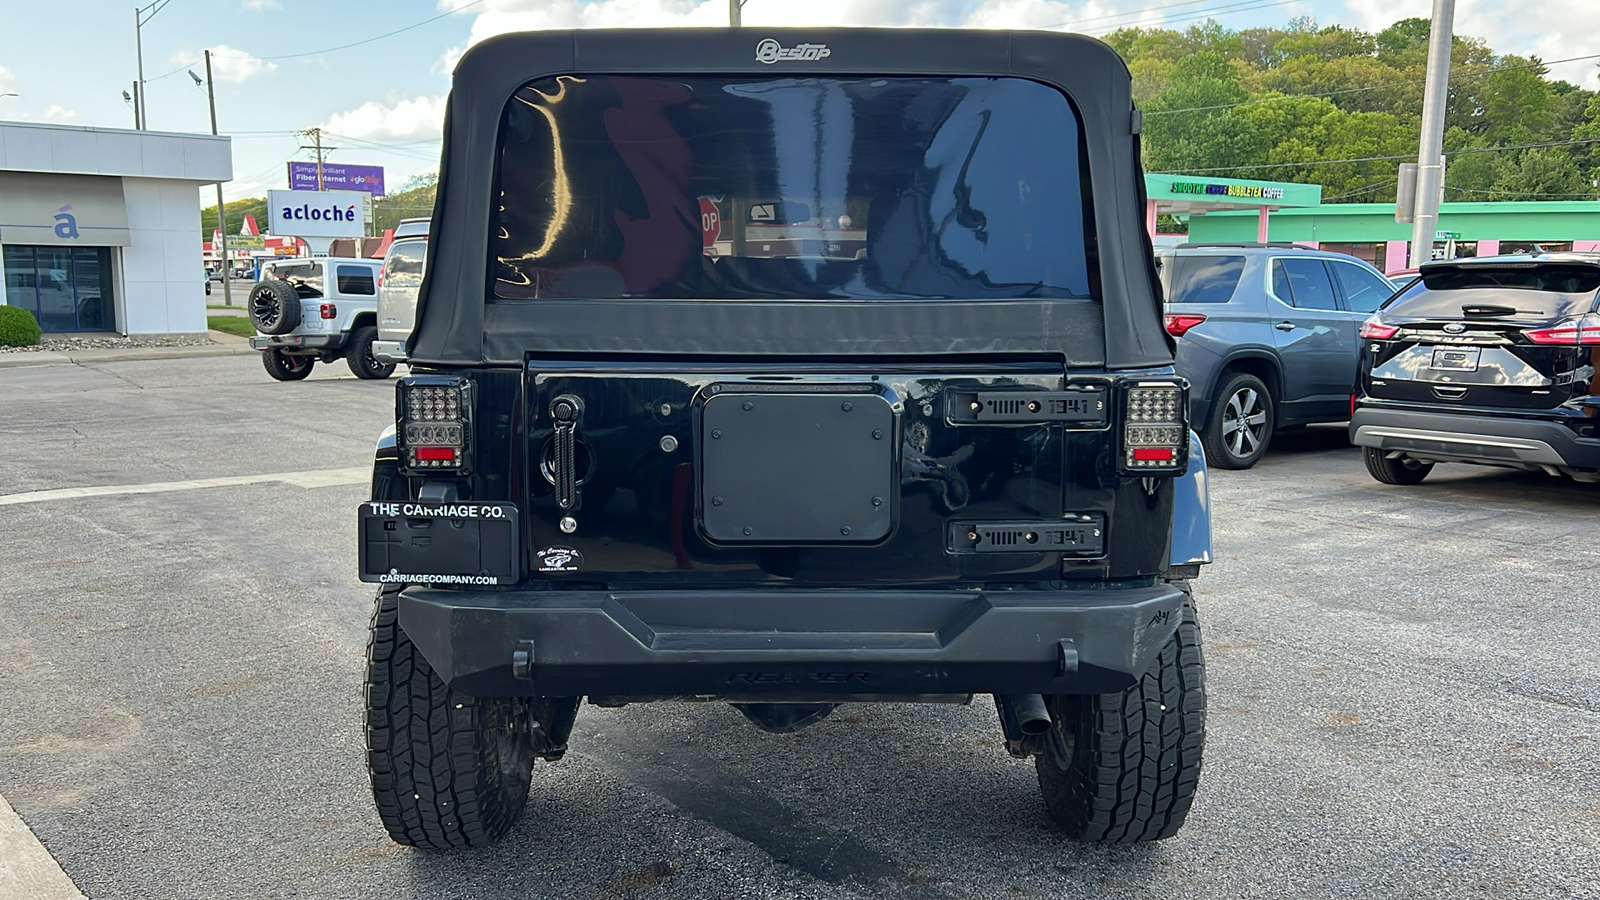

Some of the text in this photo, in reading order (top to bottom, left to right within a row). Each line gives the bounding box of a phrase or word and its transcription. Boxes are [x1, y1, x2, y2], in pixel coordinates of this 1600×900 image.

[295, 165, 318, 174] Simply
[1227, 185, 1261, 197] BUBBLETEA
[1262, 186, 1284, 199] COFFEE
[282, 204, 355, 221] acloché
[370, 502, 506, 519] THE CARRIAGE CO.
[379, 574, 498, 586] CARRIAGECOMPANY.COM
